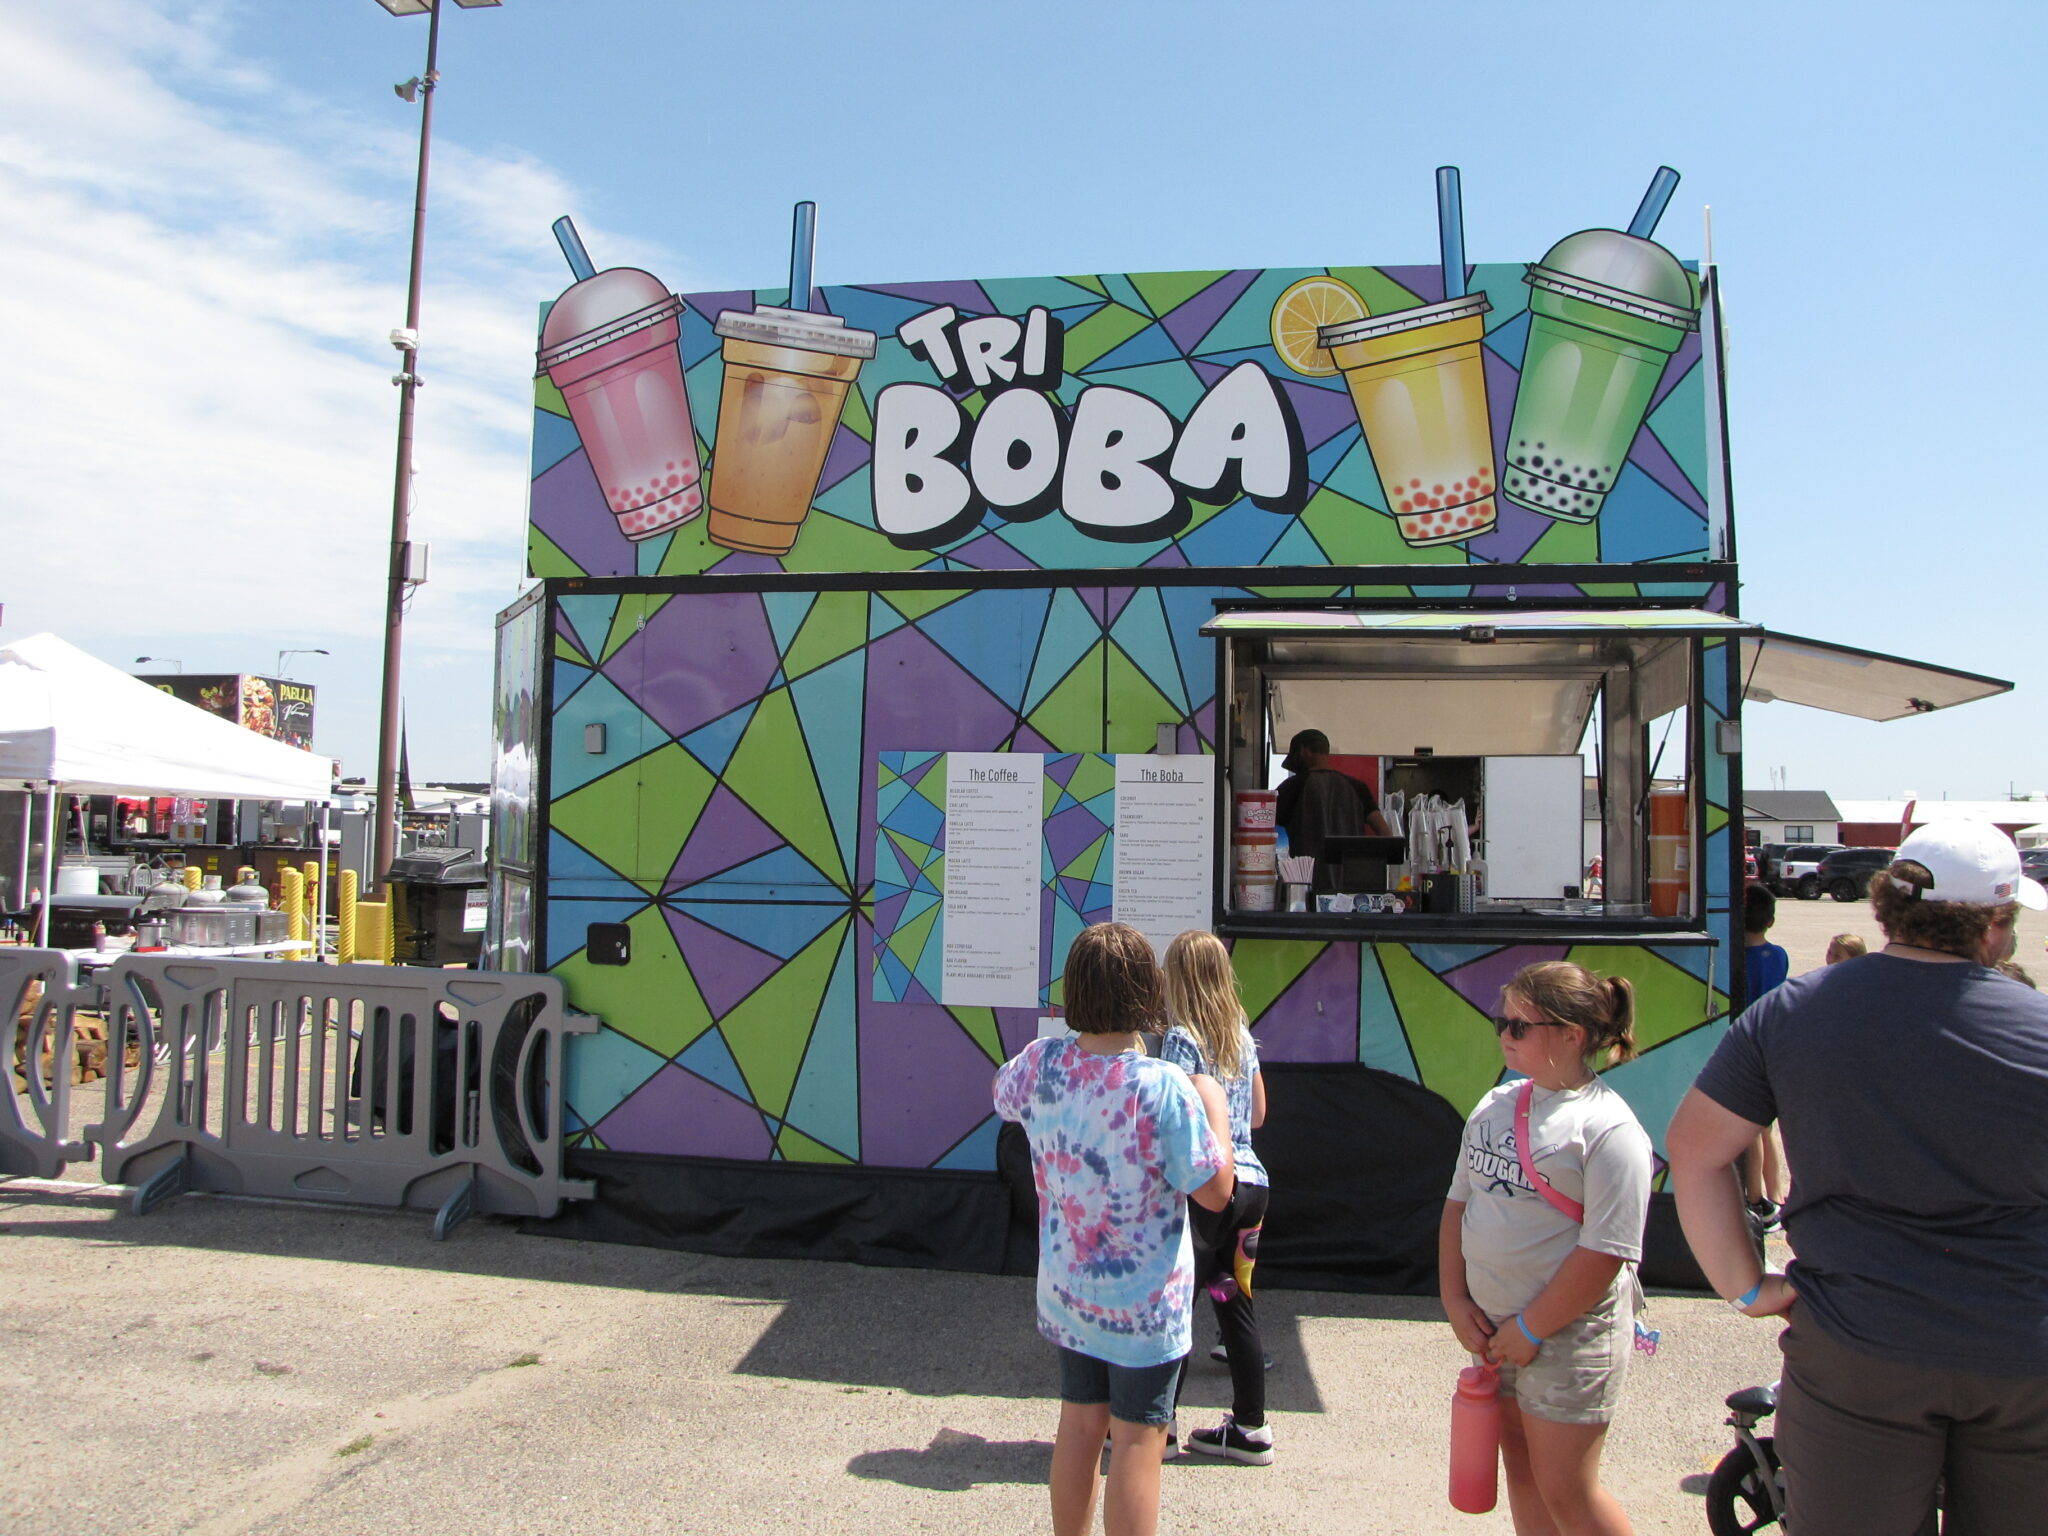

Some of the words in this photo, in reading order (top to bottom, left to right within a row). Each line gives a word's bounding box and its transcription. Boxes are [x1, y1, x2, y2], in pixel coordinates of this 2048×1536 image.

[896, 304, 1063, 390] TRI
[871, 360, 1307, 548] BOBA
[280, 684, 314, 706] PAELLA
[969, 769, 985, 781] The
[988, 769, 1018, 782] Coffee
[1141, 769, 1157, 782] The
[1160, 769, 1184, 782] Boba
